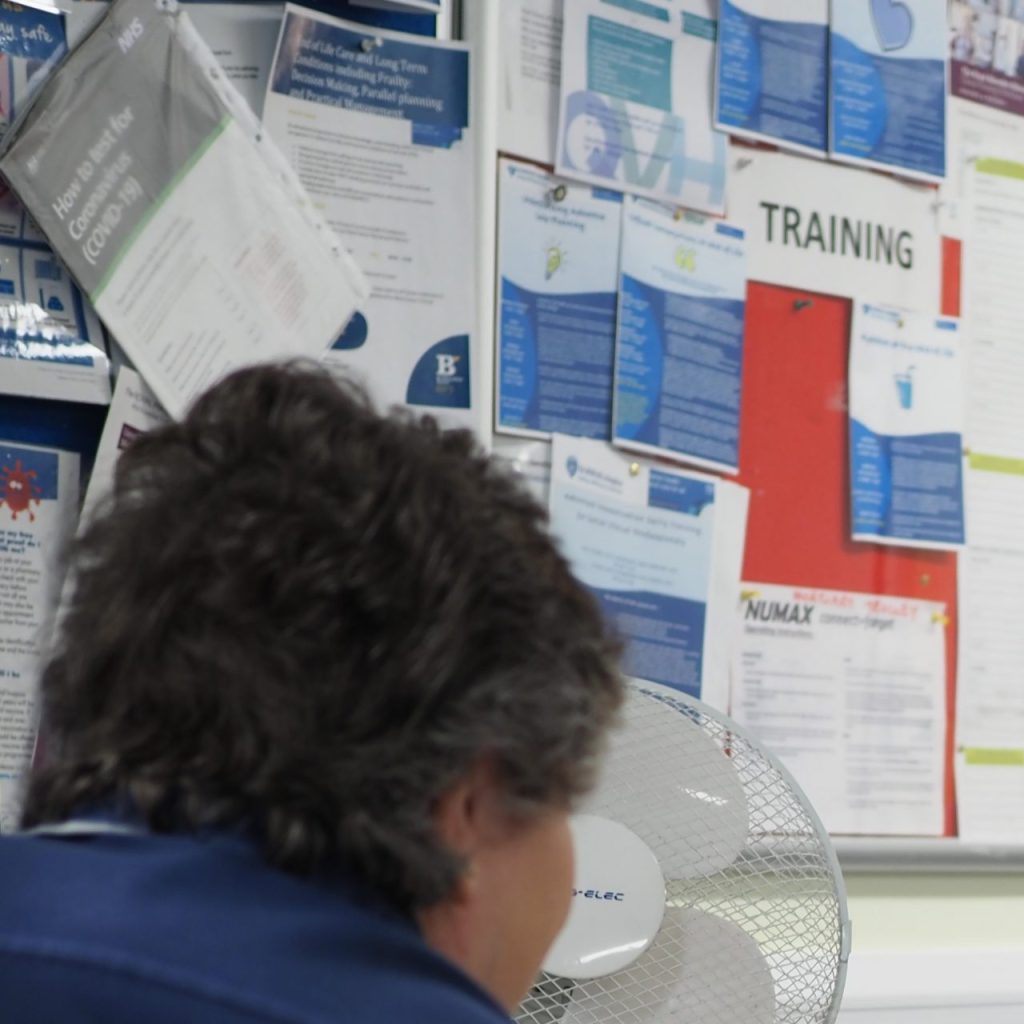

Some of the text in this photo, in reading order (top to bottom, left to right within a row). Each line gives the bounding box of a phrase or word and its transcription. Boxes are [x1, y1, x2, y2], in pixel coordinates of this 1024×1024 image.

[117, 17, 144, 54] NHS
[336, 46, 355, 60] Care
[356, 50, 374, 65] and
[375, 54, 399, 72] Long
[400, 59, 428, 75] Term
[292, 68, 326, 87] Decision
[398, 93, 444, 112] planning
[52, 106, 135, 220] How to test for
[69, 151, 133, 240] Coronavirus
[82, 175, 144, 266] (COVID-19)
[759, 201, 913, 270] TRAINING
[745, 600, 814, 626] NUMAX
